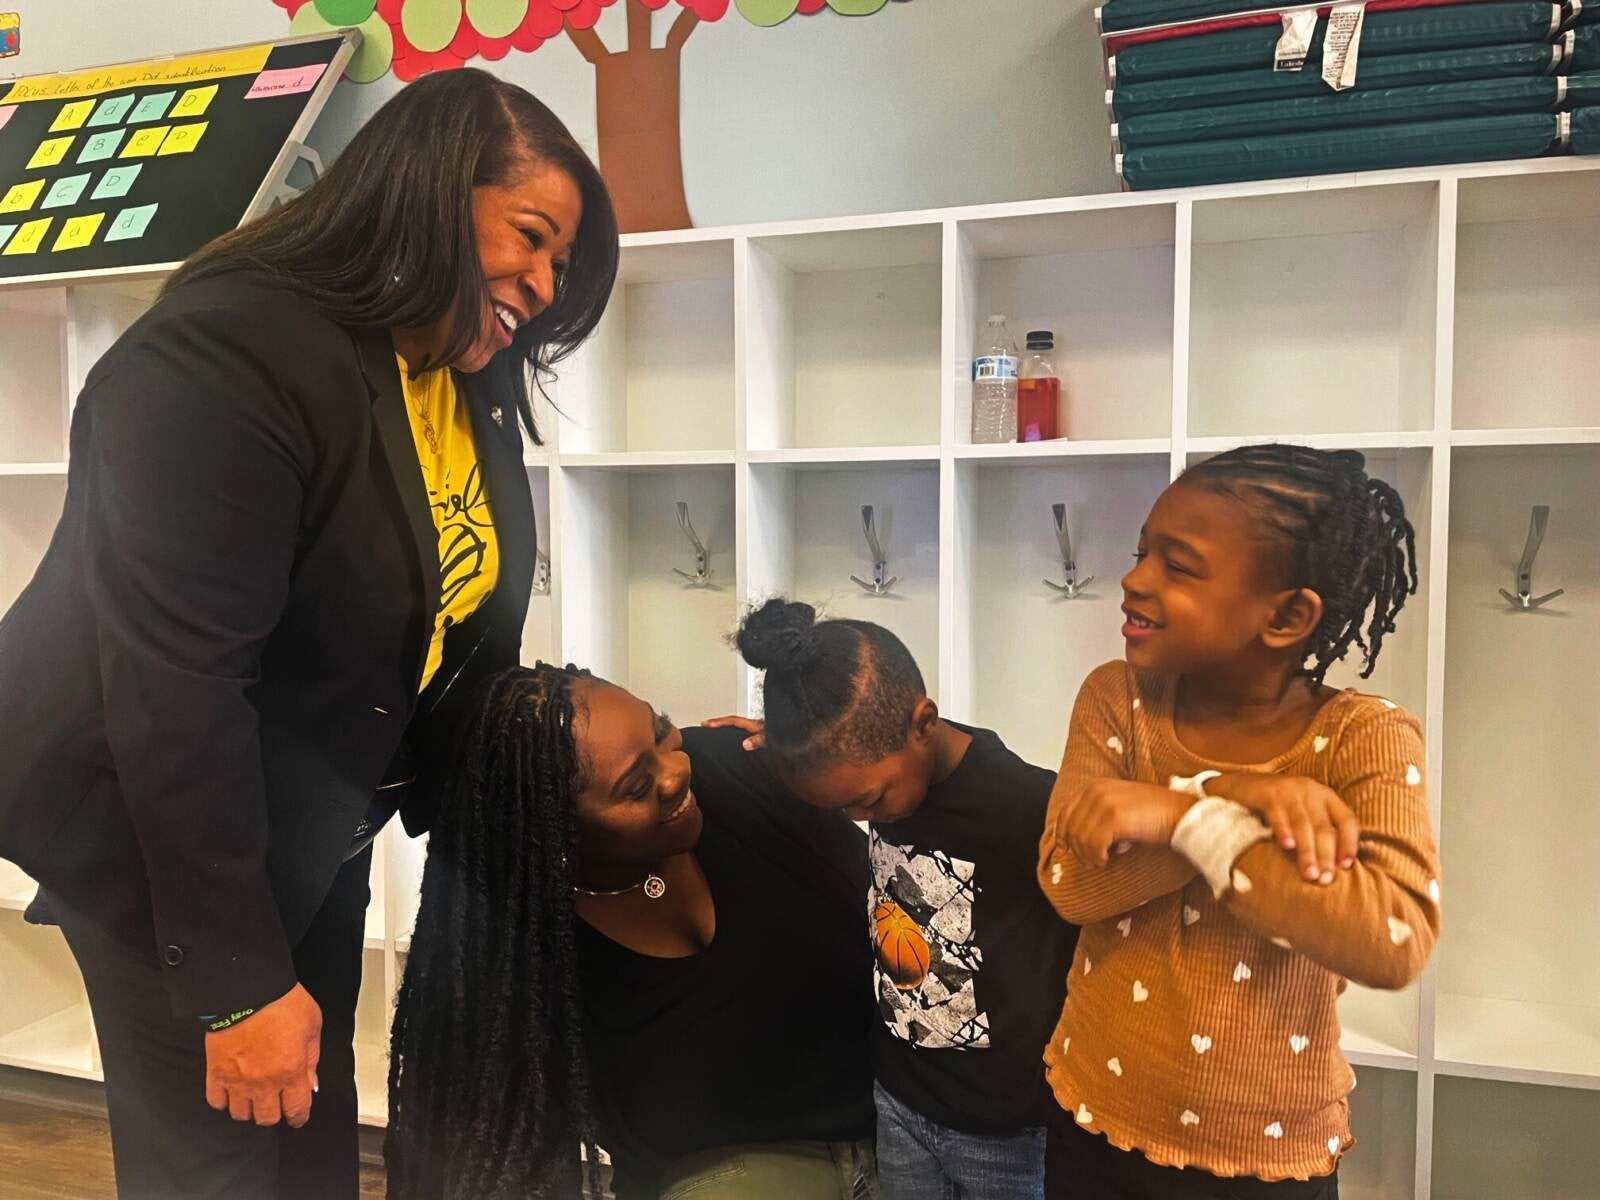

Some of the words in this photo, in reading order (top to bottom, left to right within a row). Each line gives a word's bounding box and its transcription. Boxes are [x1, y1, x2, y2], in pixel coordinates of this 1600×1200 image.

[182, 94, 198, 108] D
[62, 108, 73, 122] A
[103, 101, 120, 116] d
[43, 143, 56, 157] d
[92, 138, 106, 151] B
[105, 174, 121, 187] D
[121, 213, 136, 230] d
[21, 226, 37, 243] d
